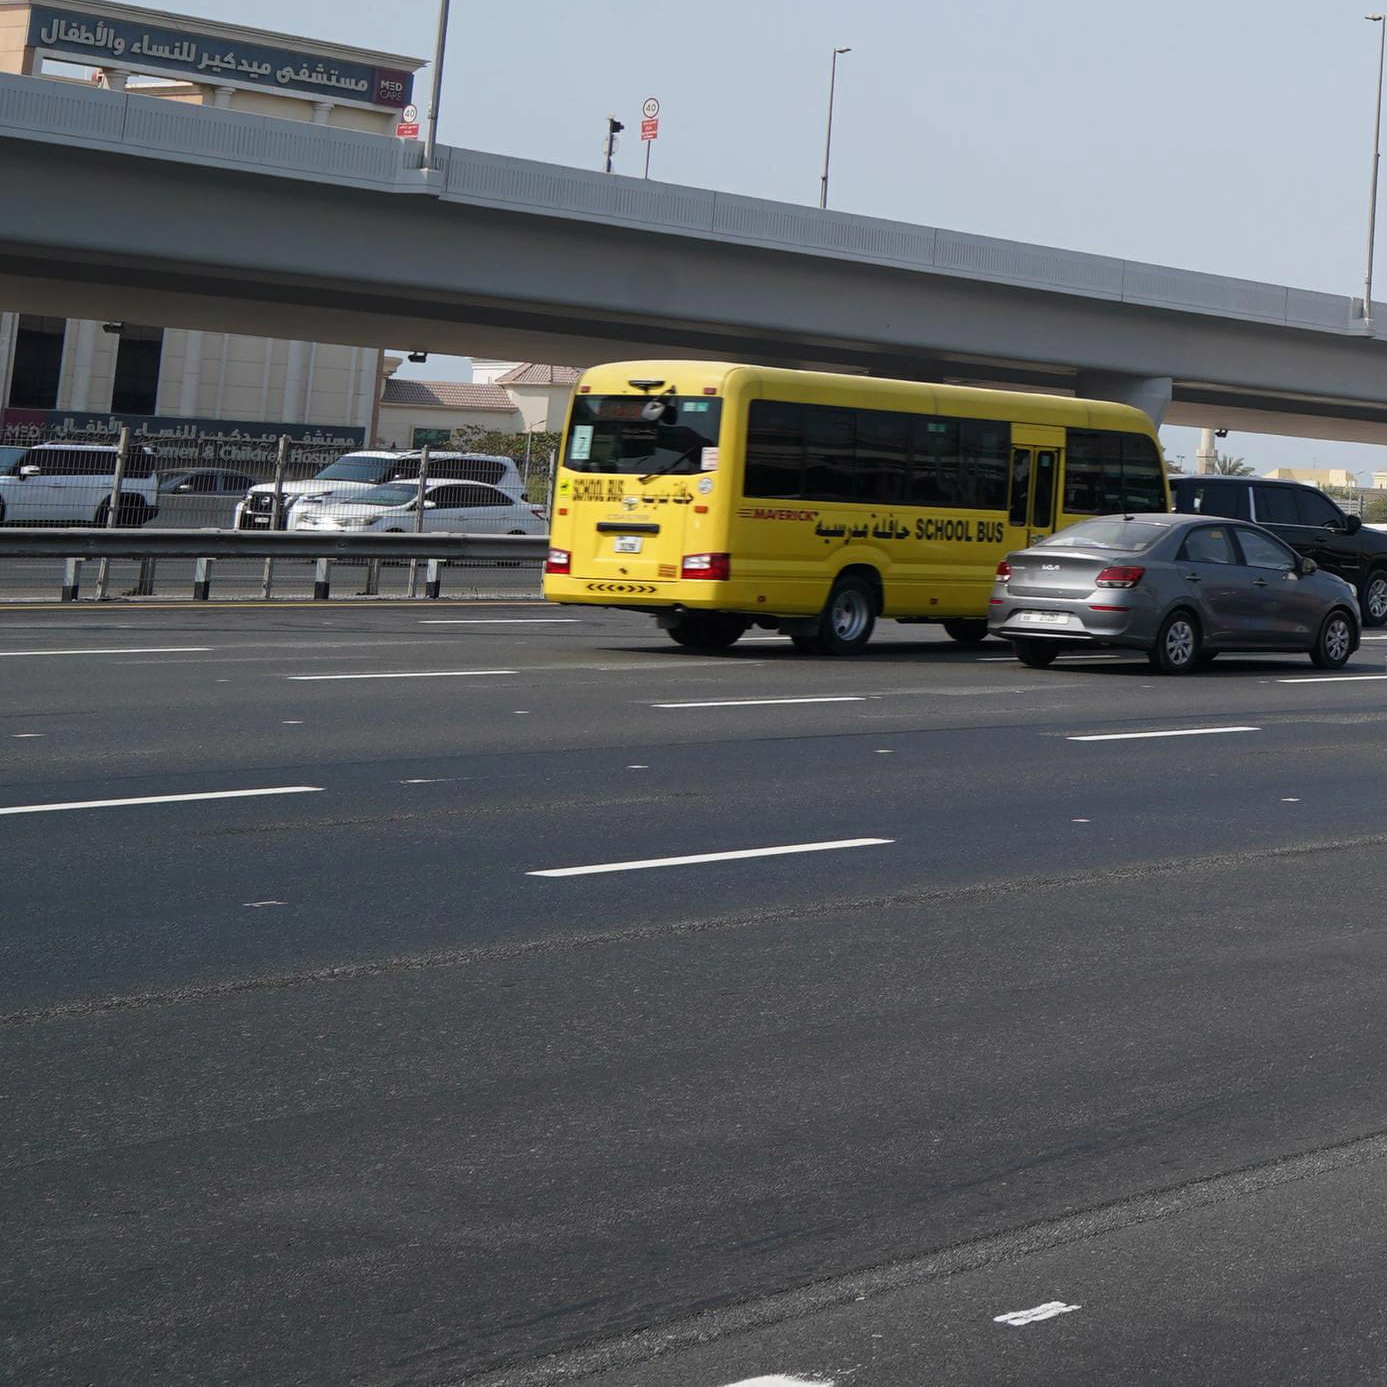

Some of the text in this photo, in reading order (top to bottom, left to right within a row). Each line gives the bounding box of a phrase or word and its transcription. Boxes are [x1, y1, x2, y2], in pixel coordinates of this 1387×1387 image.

[40, 17, 369, 93] مستشفى ميدكير للنساء والأطفال
[380, 80, 403, 92] MED
[380, 89, 402, 102] CARE
[404, 108, 415, 118] 40
[645, 103, 657, 112] 40
[915, 518, 1004, 543] SCHOOL BUS
